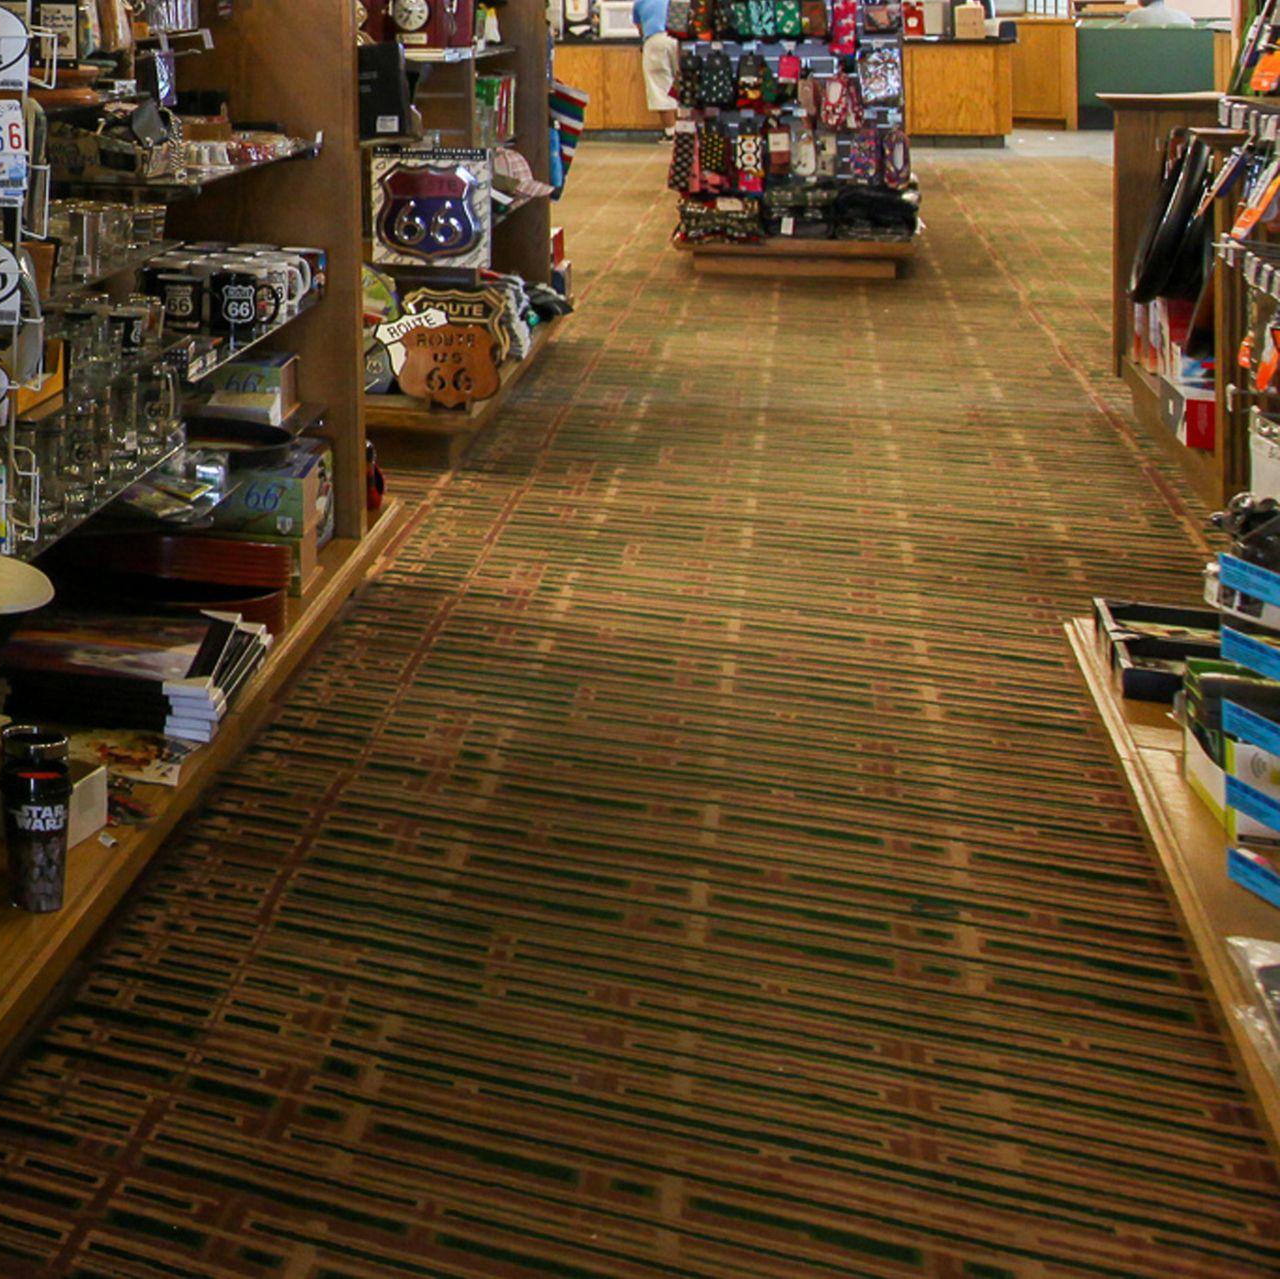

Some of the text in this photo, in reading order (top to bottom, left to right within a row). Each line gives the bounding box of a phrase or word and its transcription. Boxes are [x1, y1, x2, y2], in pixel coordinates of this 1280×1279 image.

[395, 199, 464, 246] 66
[166, 297, 191, 314] 66
[227, 301, 250, 318] 66
[387, 313, 436, 338] ROUTE
[416, 332, 476, 348] ROUTE
[426, 367, 474, 392] 66
[14, 804, 66, 819] STAR
[16, 817, 66, 832] WARS
